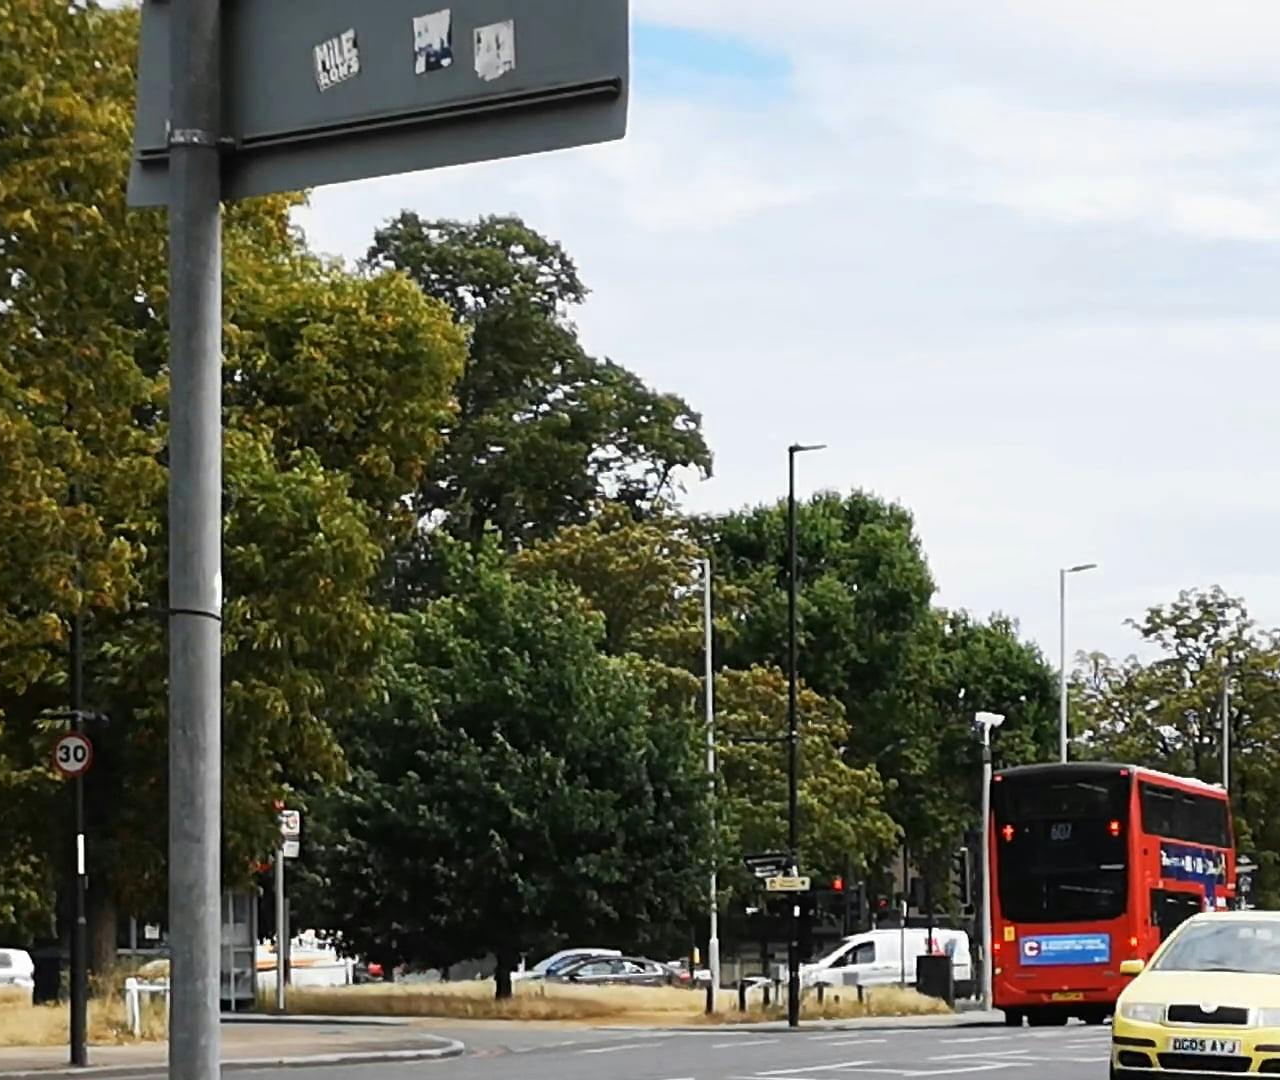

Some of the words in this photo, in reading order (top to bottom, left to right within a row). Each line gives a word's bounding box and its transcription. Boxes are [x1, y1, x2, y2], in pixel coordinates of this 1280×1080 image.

[59, 745, 86, 763] 30
[1051, 823, 1071, 840] 607
[1211, 1040, 1236, 1054] AYJ
